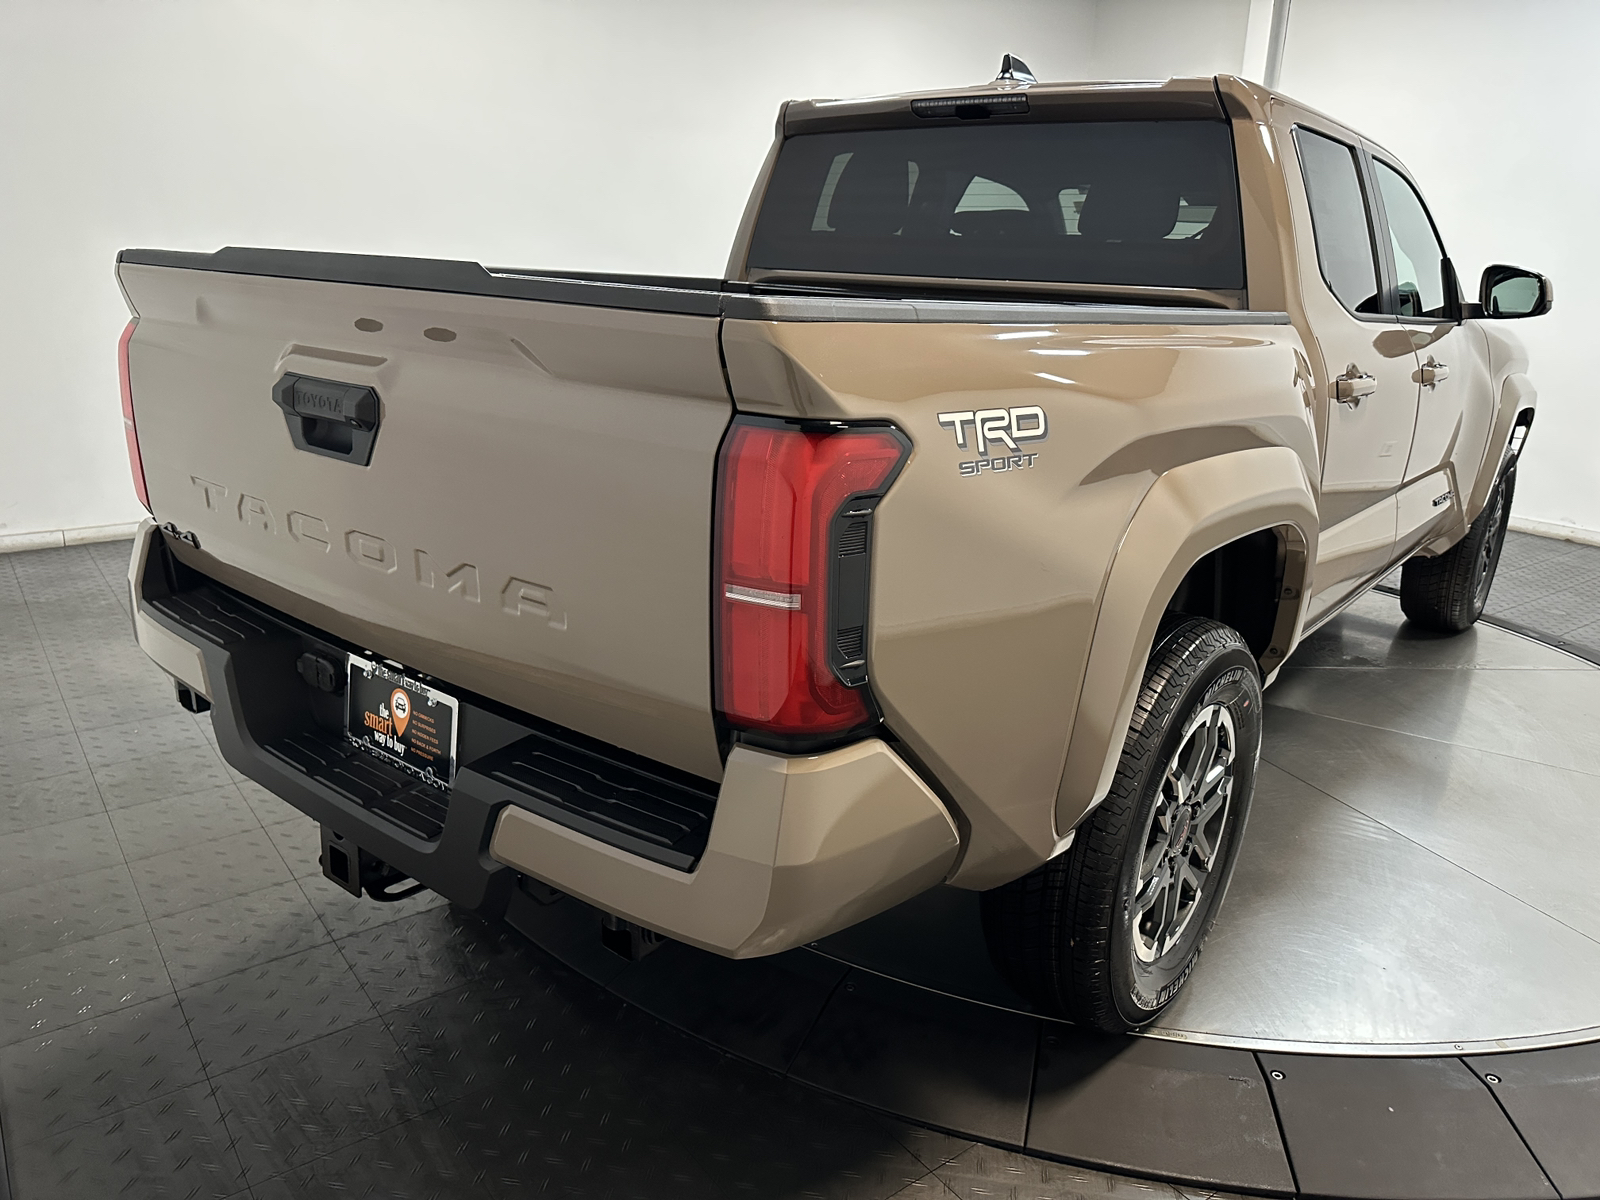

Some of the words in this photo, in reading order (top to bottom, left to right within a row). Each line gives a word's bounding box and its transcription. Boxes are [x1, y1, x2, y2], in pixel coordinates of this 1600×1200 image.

[296, 391, 342, 414] TOYOTA
[937, 405, 1050, 460] TRD
[958, 453, 1039, 477] SPORT
[190, 474, 568, 631] TACOMA
[1203, 669, 1243, 706] MICHELIN
[364, 711, 393, 736] smart
[379, 702, 390, 719] the
[374, 730, 386, 747] way
[386, 733, 393, 748] to
[393, 735, 406, 756] buy
[1158, 950, 1199, 1004] MICHELIN
